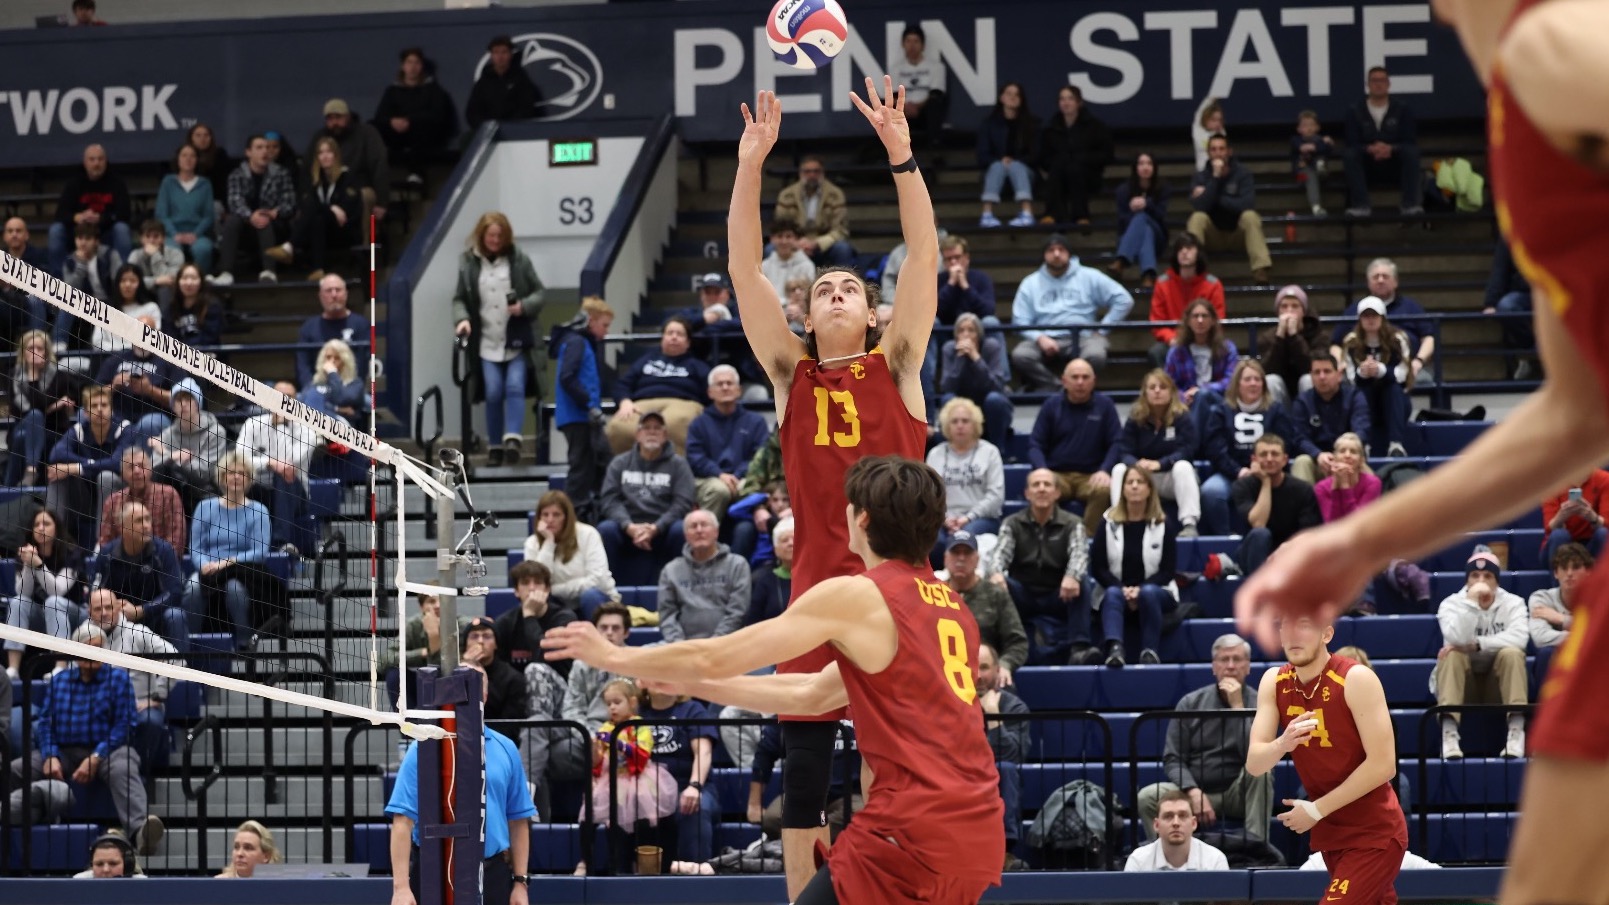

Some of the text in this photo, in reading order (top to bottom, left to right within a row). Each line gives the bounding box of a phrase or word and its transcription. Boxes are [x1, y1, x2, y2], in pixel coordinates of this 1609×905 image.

[790, 5, 811, 28] molten
[674, 4, 1434, 118] PENN STATE
[552, 142, 594, 163] EXIT
[559, 196, 595, 226] S3
[2, 252, 110, 325] STATE VOLLEYBALL
[142, 323, 171, 354] PENN
[171, 339, 201, 369] STATE
[202, 352, 256, 396] VOLLEYBALL
[281, 393, 374, 451] PENN STATE VOLLEYBALL
[813, 387, 861, 447] 13
[1234, 412, 1264, 444] S
[914, 577, 960, 610] USC
[937, 618, 977, 706] 8
[1328, 878, 1350, 895] 24
